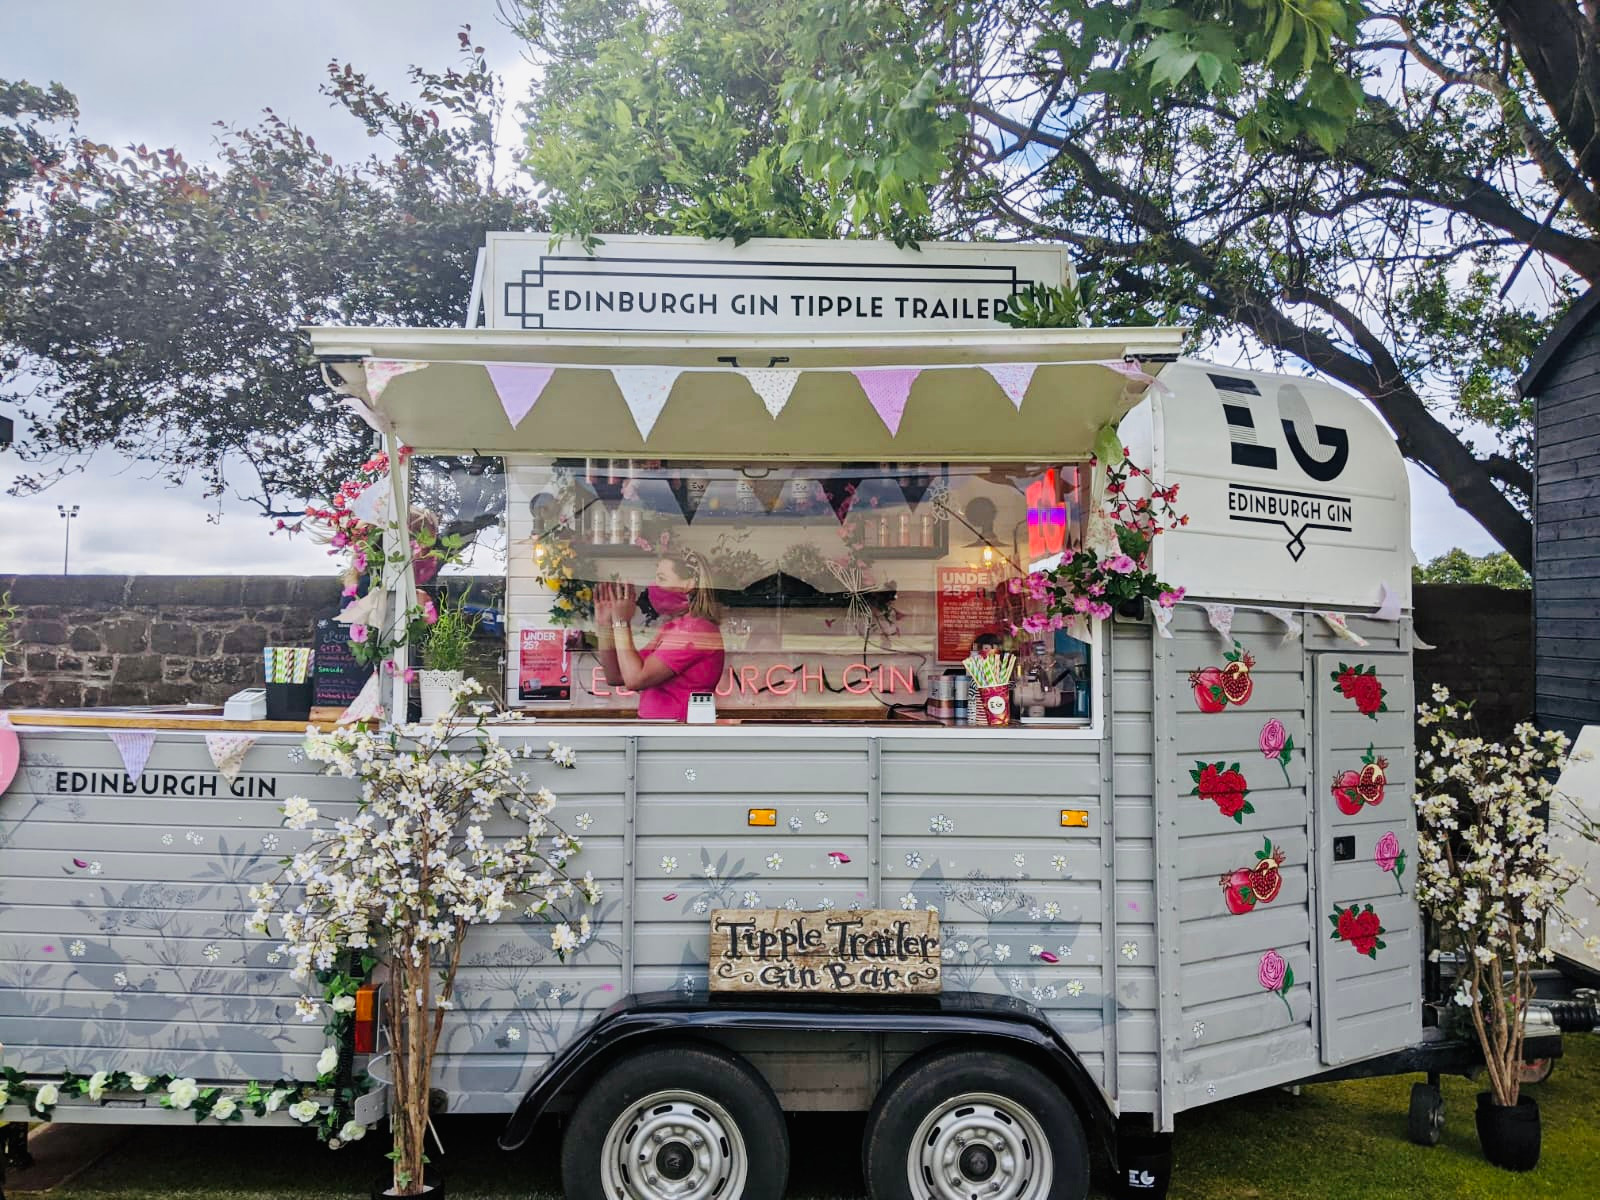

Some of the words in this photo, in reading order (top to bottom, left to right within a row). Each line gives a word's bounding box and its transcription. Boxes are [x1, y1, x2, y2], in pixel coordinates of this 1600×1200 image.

[547, 289, 718, 315] EDINBURGH
[730, 293, 778, 317] GIN
[790, 294, 883, 319] TIPPLE
[1228, 491, 1321, 521] EDINBURGH
[1327, 503, 1352, 523] GIN
[943, 585, 970, 596] 25?
[523, 632, 556, 641] UNDER
[842, 663, 915, 695] GIN
[56, 771, 217, 797] EDINBURGH
[230, 776, 276, 798] GIN
[715, 916, 826, 962] Tipple
[825, 916, 939, 964] Trailer
[759, 963, 822, 989] Gin
[824, 962, 901, 990] Bar
